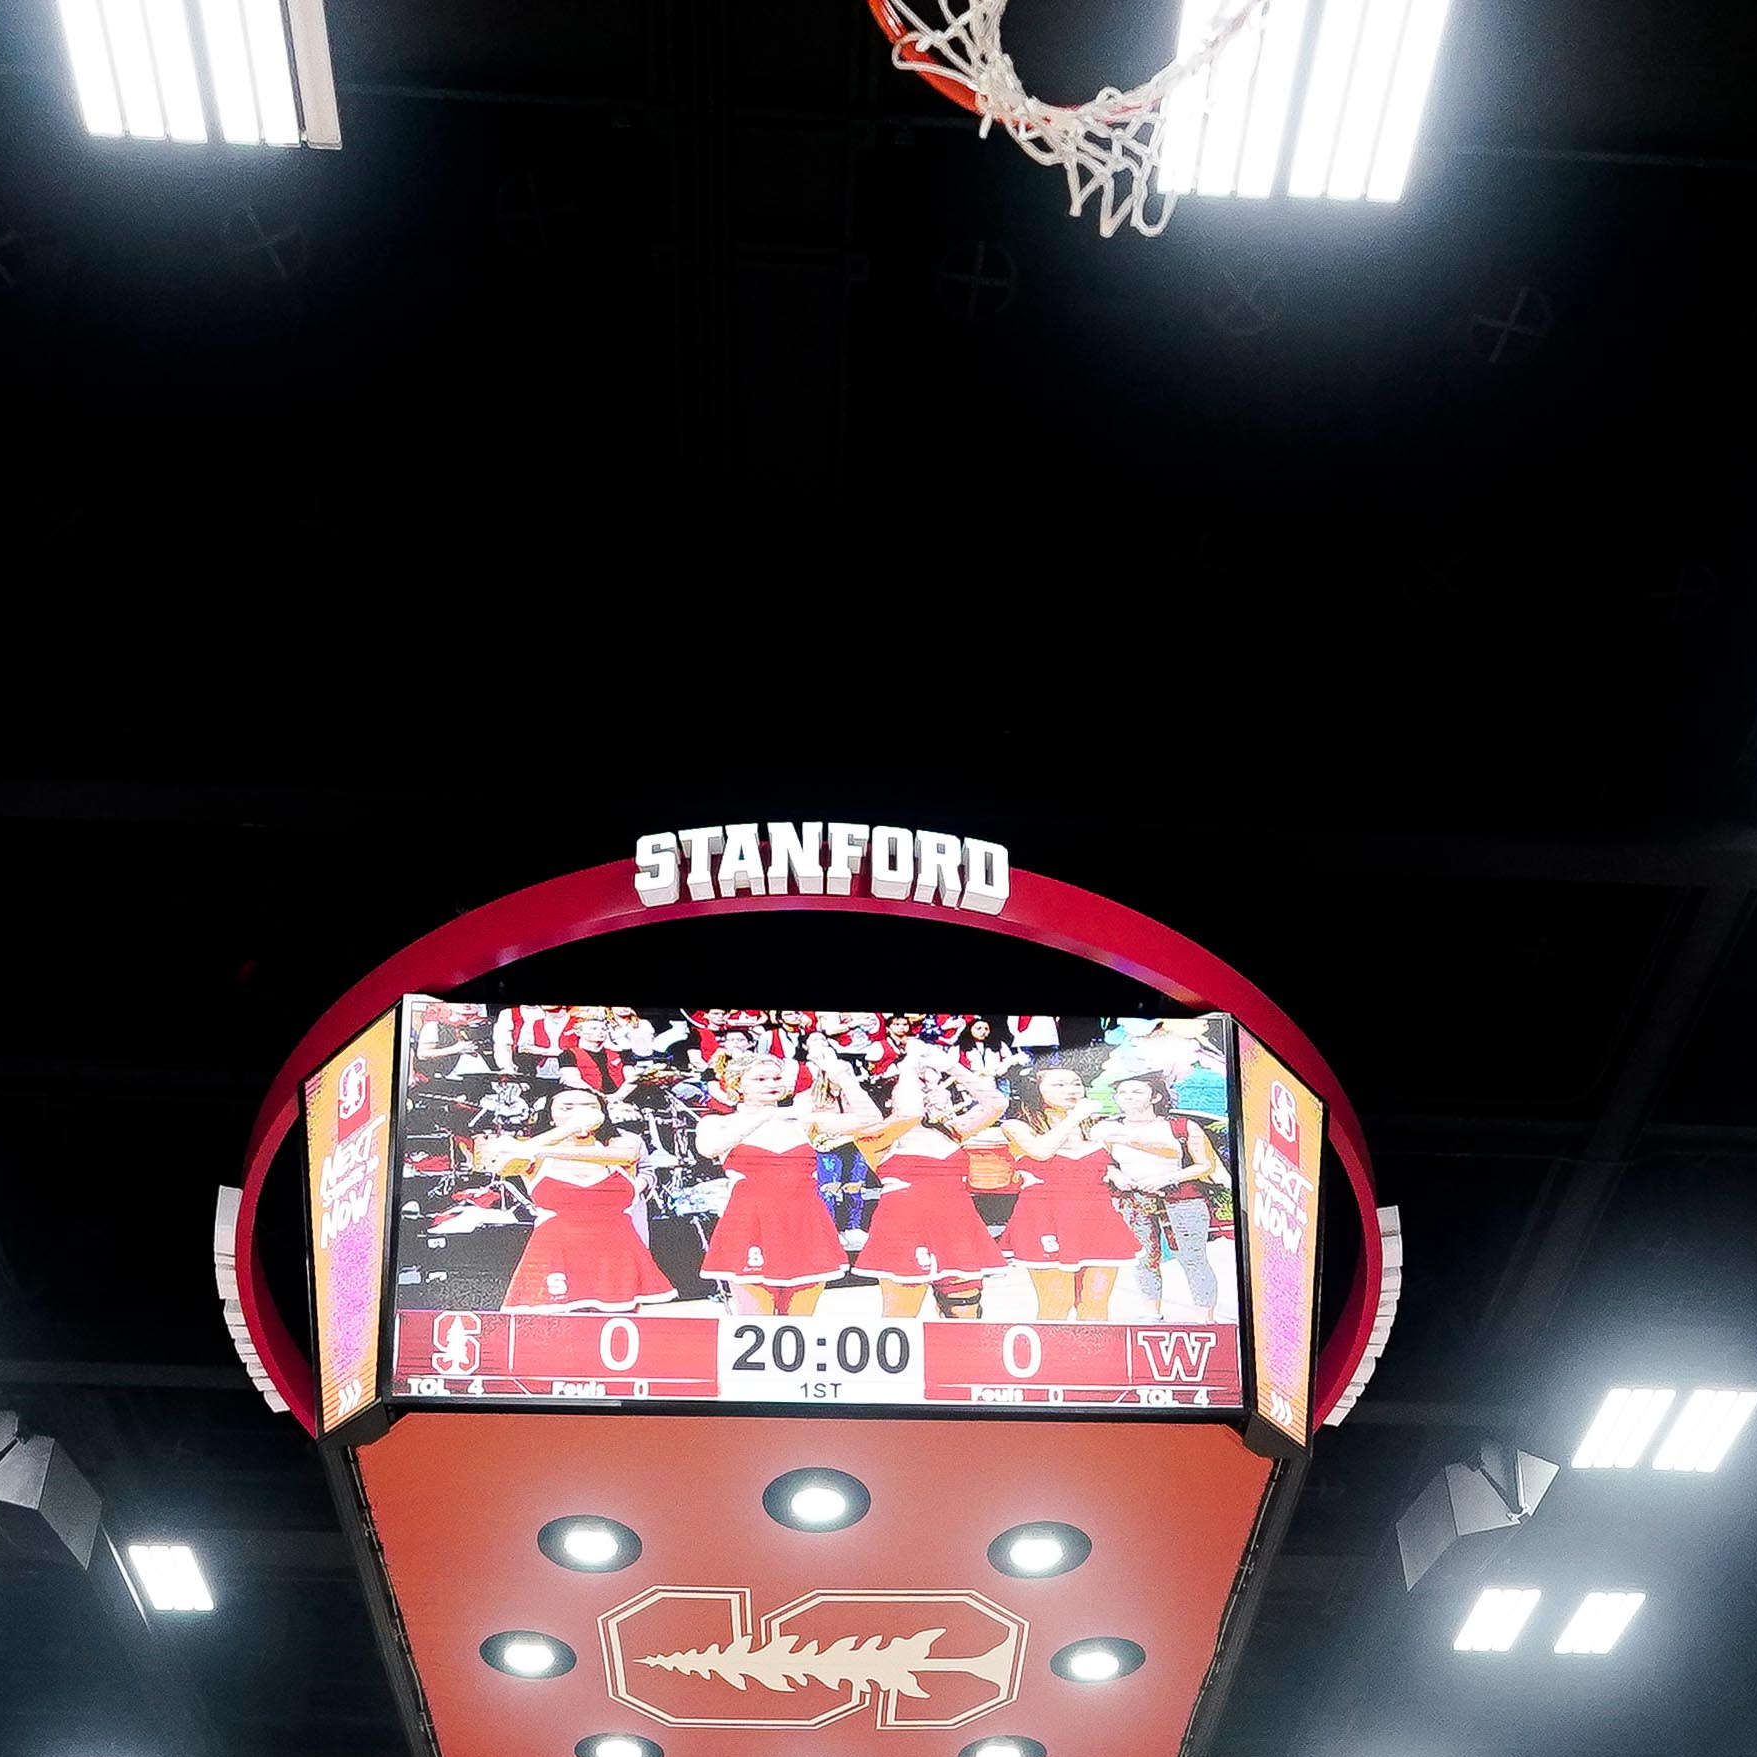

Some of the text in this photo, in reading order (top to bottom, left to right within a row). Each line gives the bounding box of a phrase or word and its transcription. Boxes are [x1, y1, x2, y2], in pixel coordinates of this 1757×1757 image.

[634, 822, 1010, 915] STANFORD
[599, 1317, 641, 1372] 0
[732, 1324, 910, 1373] 20:00
[1001, 1324, 1042, 1379] 0
[1138, 1331, 1216, 1383] W
[408, 1377, 450, 1396] TOL
[552, 1380, 649, 1398] Fouls 0
[799, 1382, 842, 1399] 1ST
